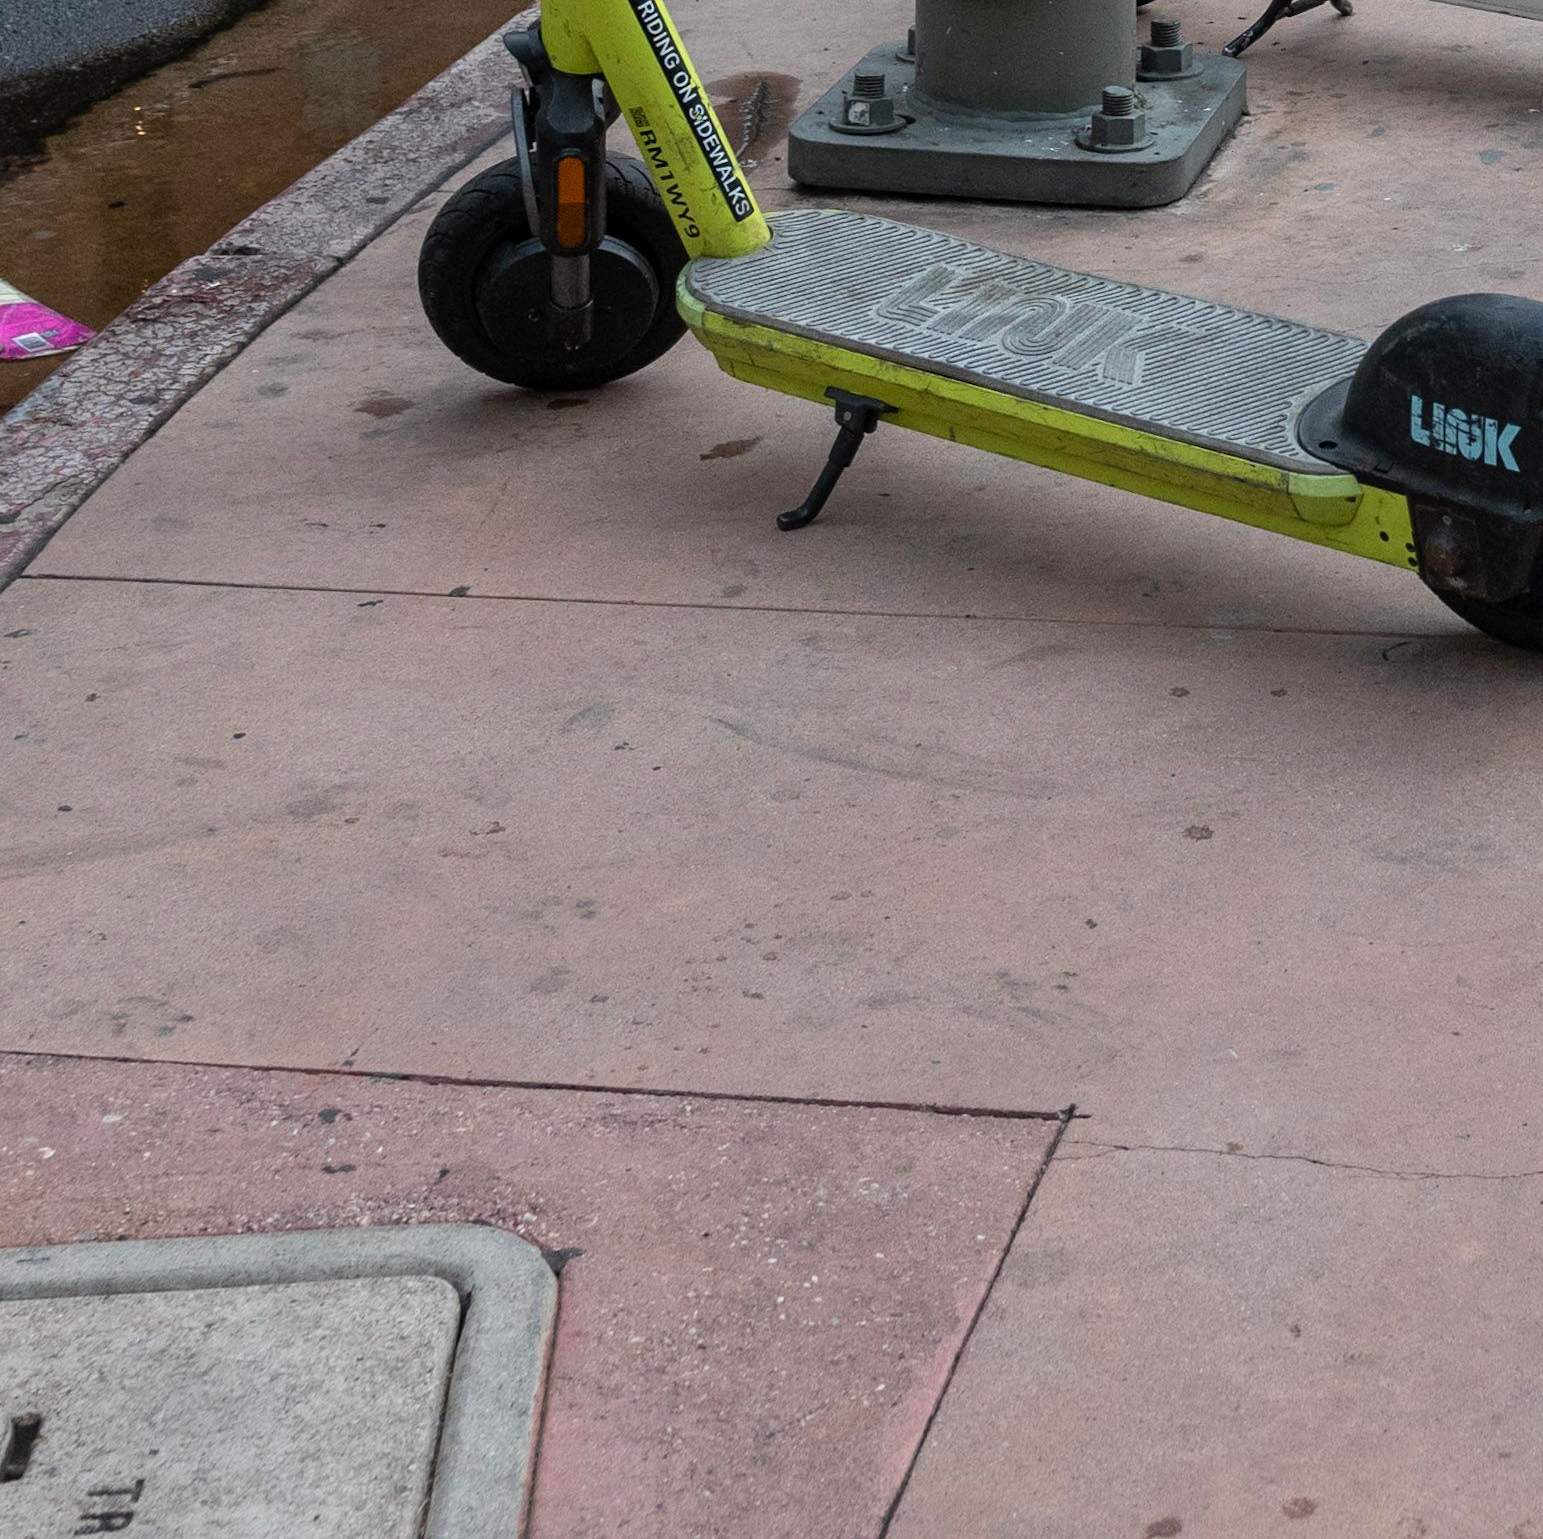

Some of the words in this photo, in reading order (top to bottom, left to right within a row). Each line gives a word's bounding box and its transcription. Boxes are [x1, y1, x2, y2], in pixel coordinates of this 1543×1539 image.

[673, 70, 698, 104] ON
[689, 104, 750, 217] SIDEWALKS
[1411, 395, 1521, 473] LINK
